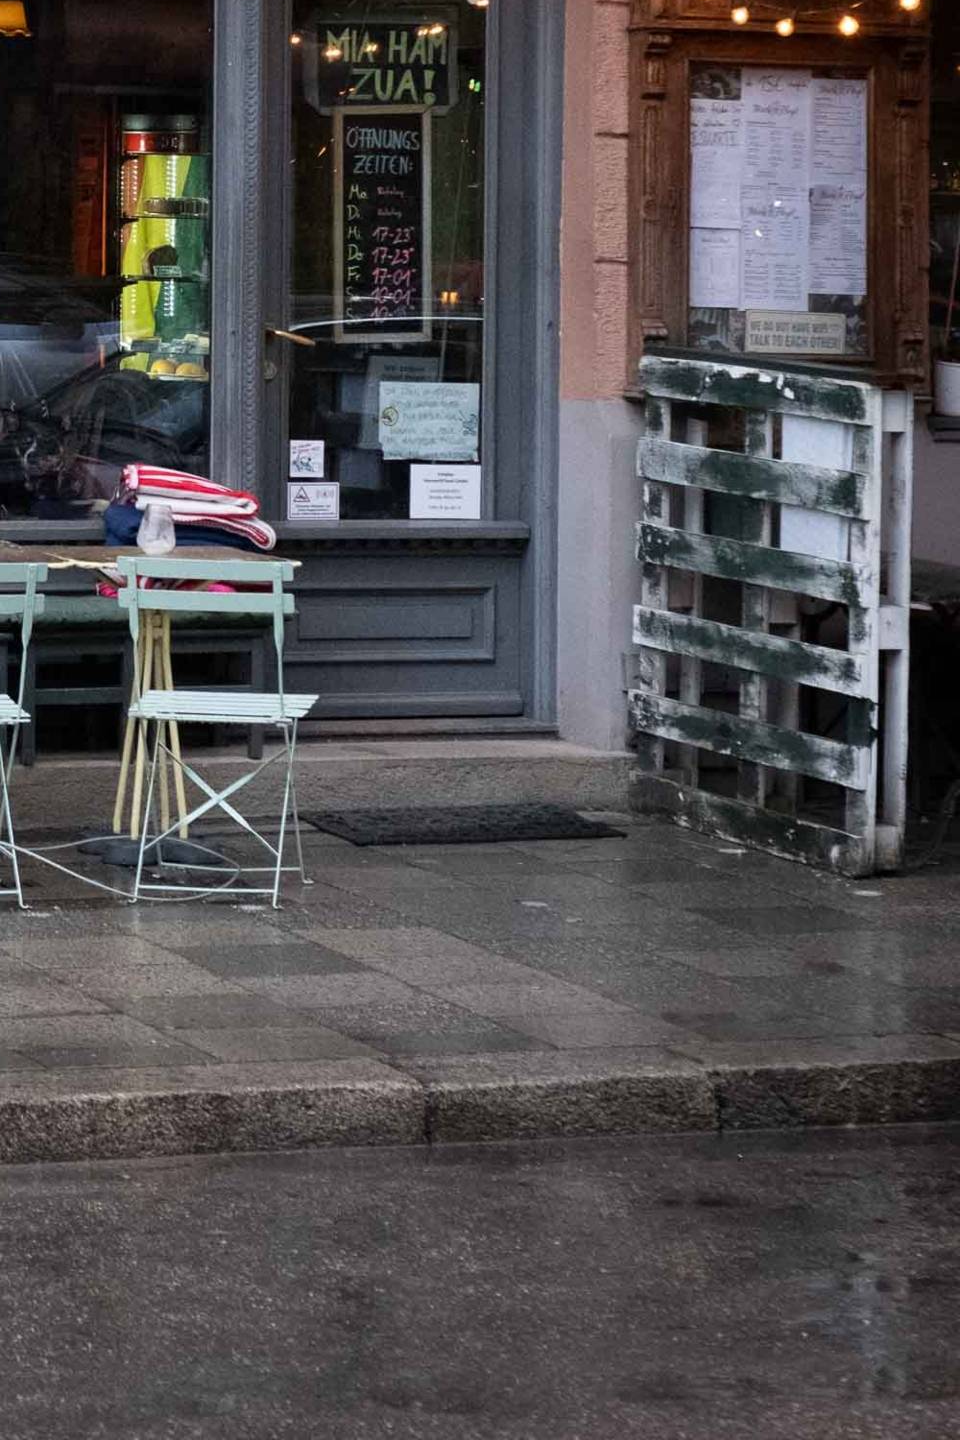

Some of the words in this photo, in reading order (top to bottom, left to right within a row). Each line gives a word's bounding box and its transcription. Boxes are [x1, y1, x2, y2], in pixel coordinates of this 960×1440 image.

[326, 27, 375, 63] MIA
[390, 29, 448, 65] HAM
[346, 68, 436, 105] ZUA!
